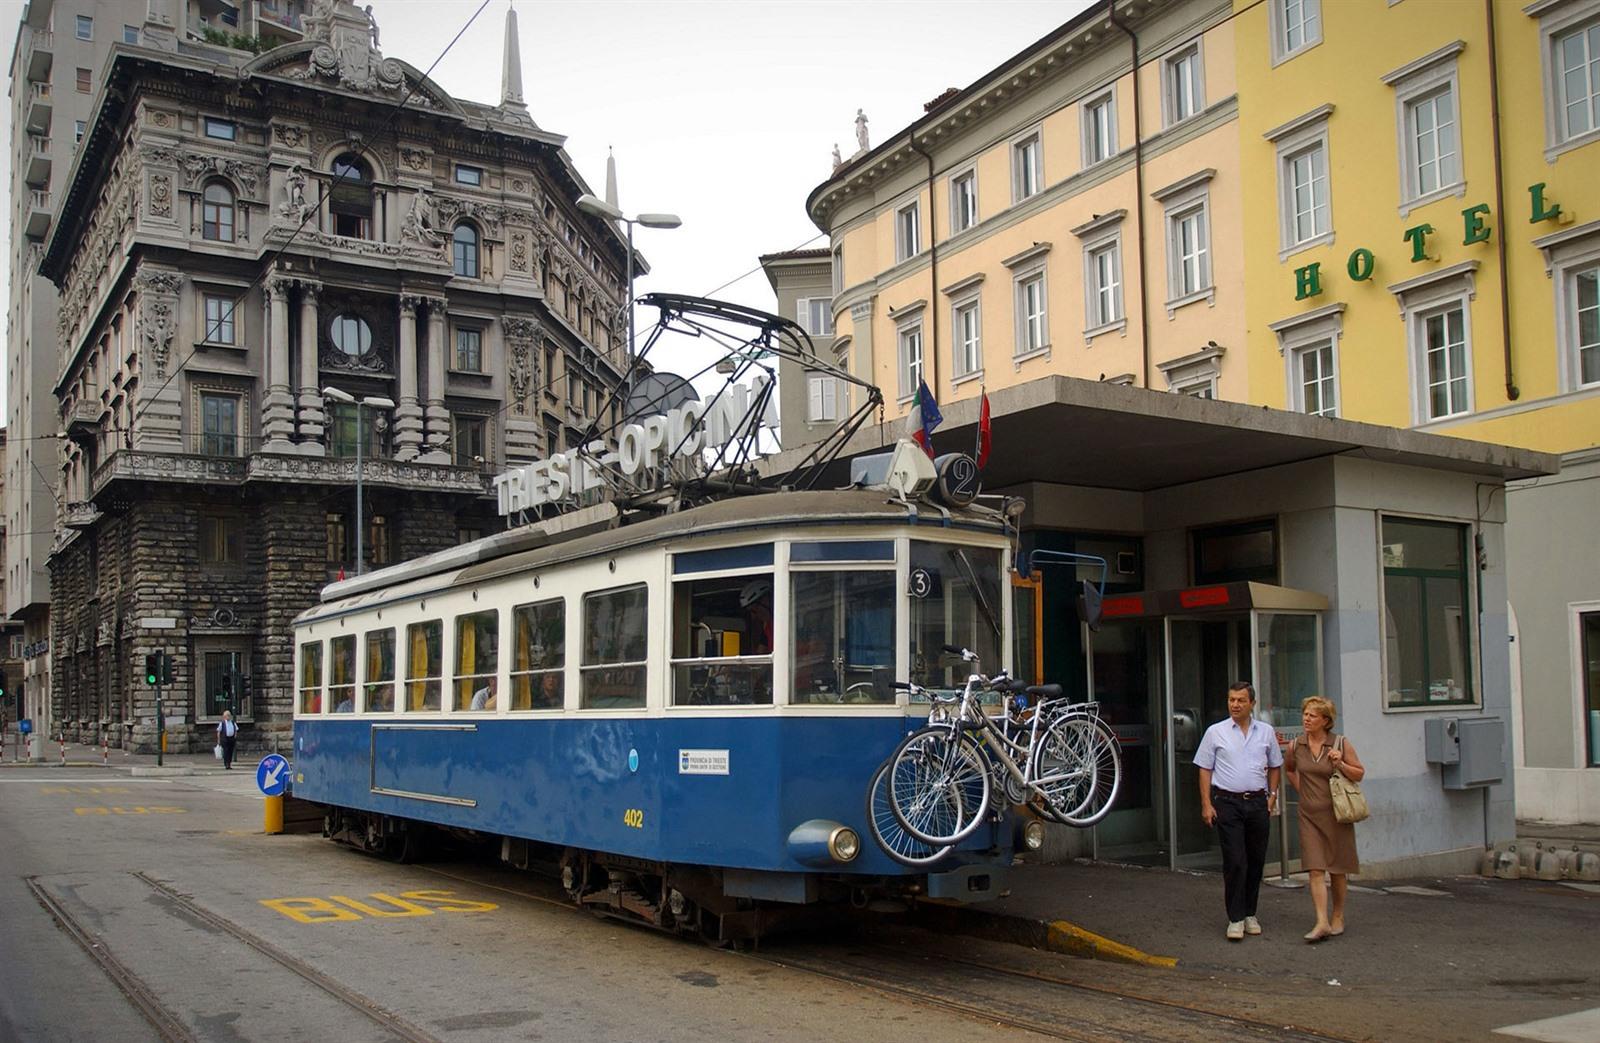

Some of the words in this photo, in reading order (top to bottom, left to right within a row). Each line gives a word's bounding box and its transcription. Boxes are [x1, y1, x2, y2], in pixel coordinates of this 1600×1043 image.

[1294, 182, 1561, 301] HOTEL
[952, 458, 975, 497] 2
[914, 573, 926, 593] 3
[624, 809, 643, 828] 402
[258, 890, 499, 923] BUS
